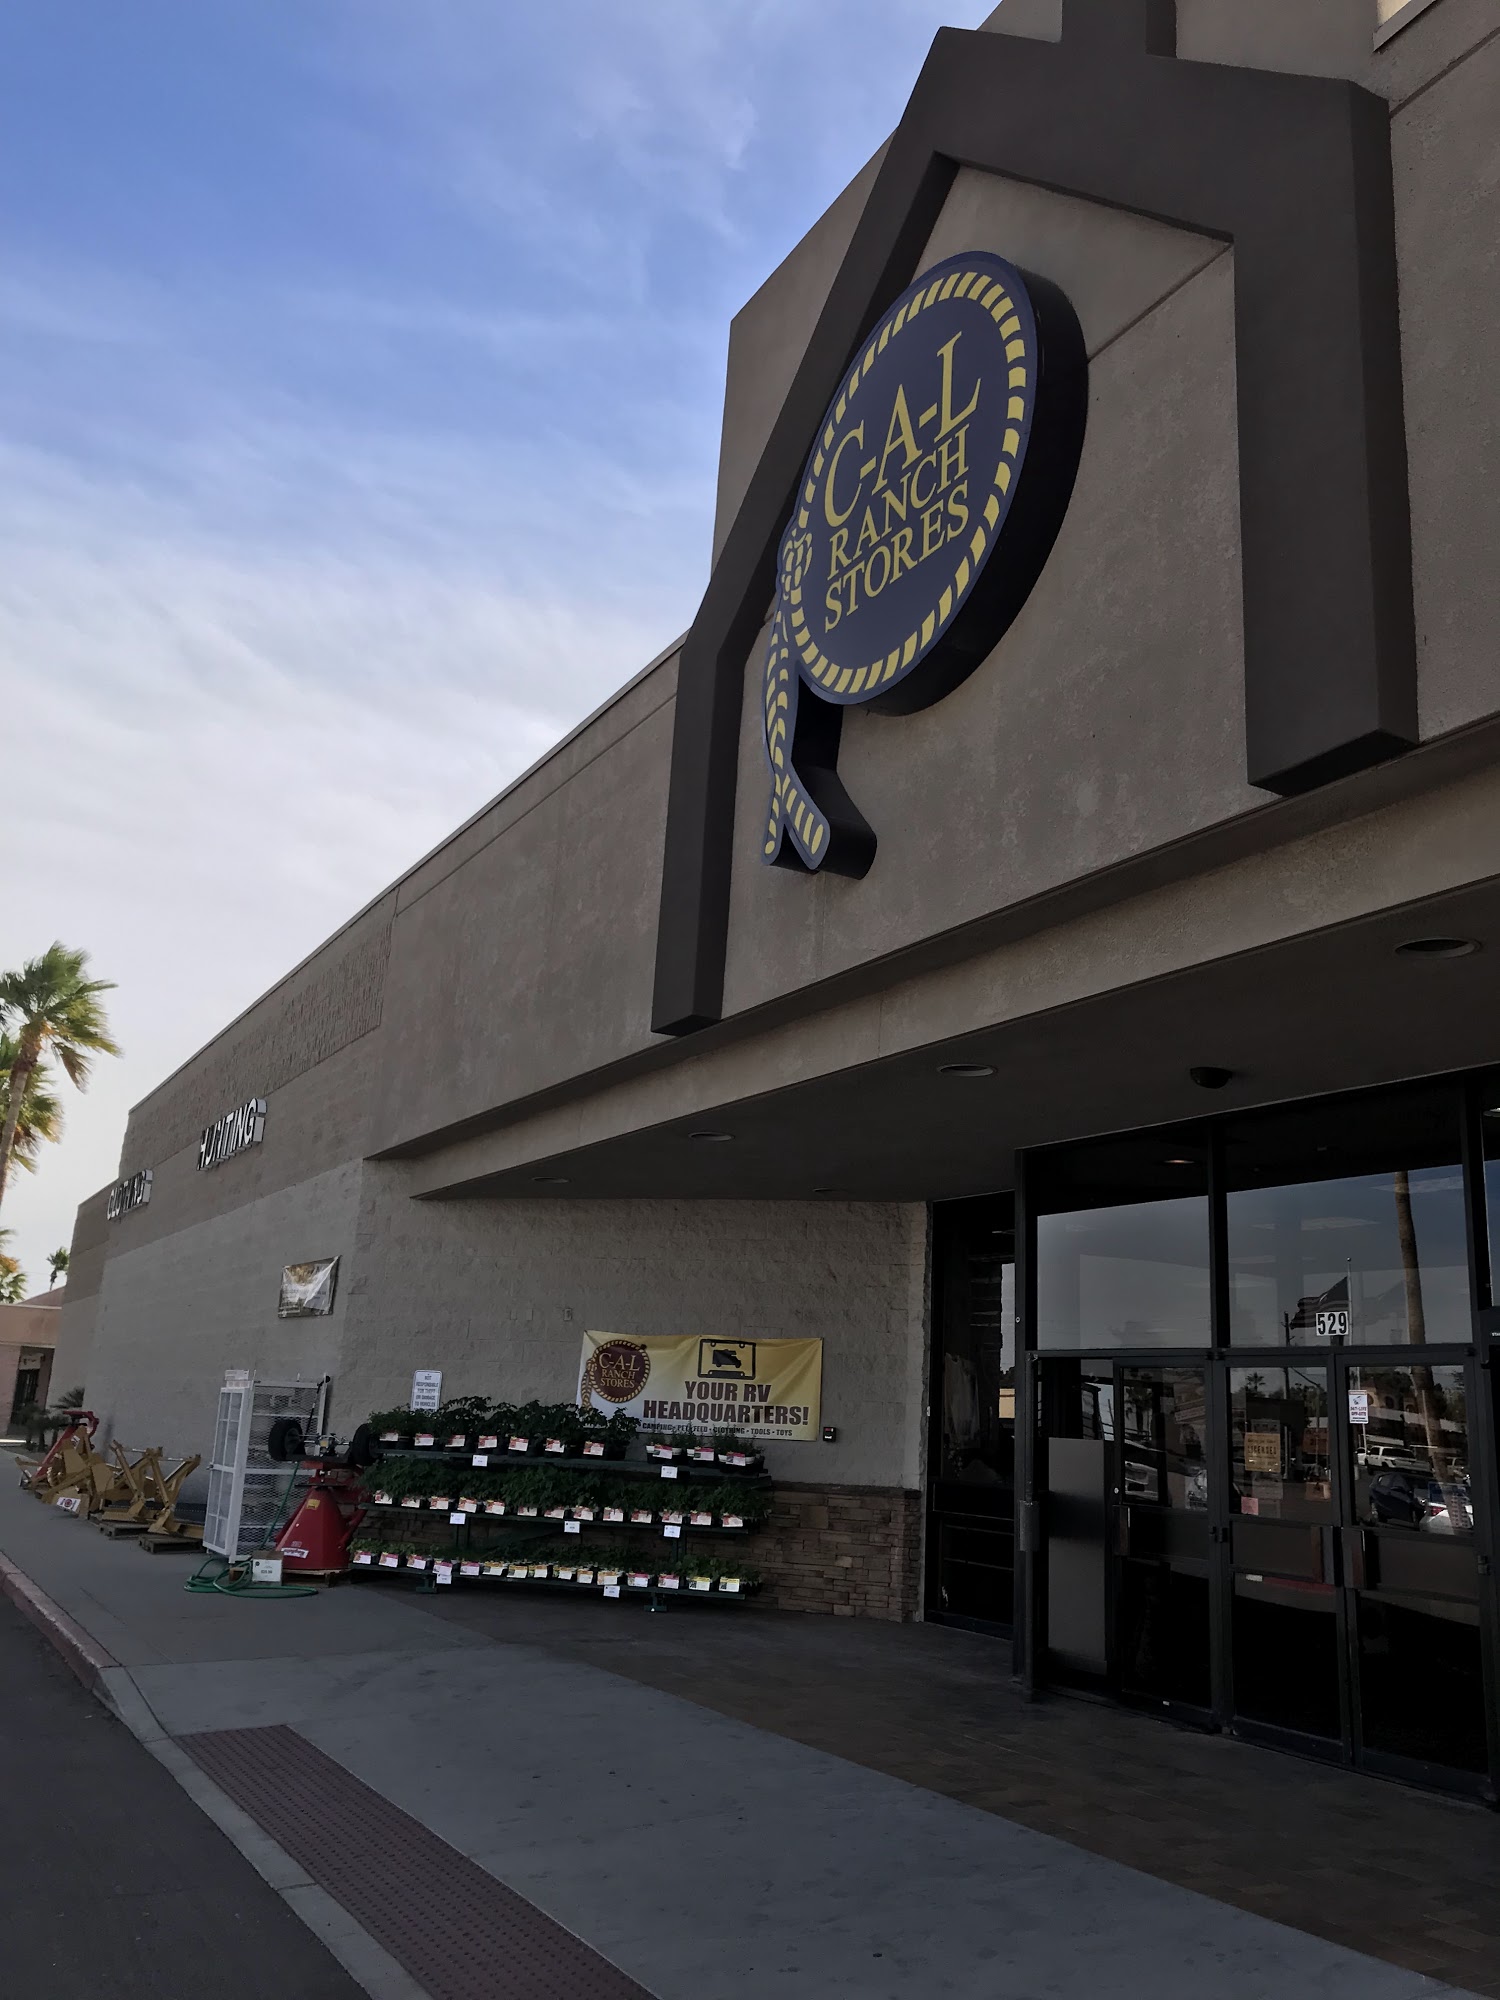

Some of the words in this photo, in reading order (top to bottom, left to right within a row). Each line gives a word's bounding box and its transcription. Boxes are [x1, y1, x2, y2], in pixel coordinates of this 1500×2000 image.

[824, 331, 981, 528] C-A-L
[827, 424, 969, 580] RANCH
[824, 480, 969, 633] STORES
[1317, 1312, 1347, 1335] 529
[598, 1352, 641, 1371] C-A-L
[600, 1378, 635, 1388] STORES
[601, 1369, 636, 1379] RANCH
[685, 1381, 737, 1402] YOUR
[743, 1384, 771, 1403] RV
[643, 1400, 809, 1426] HEADQUARTERS!
[642, 1422, 672, 1431] CAMPING
[751, 1428, 771, 1436] TOOLS
[776, 1429, 793, 1437] TOYS
